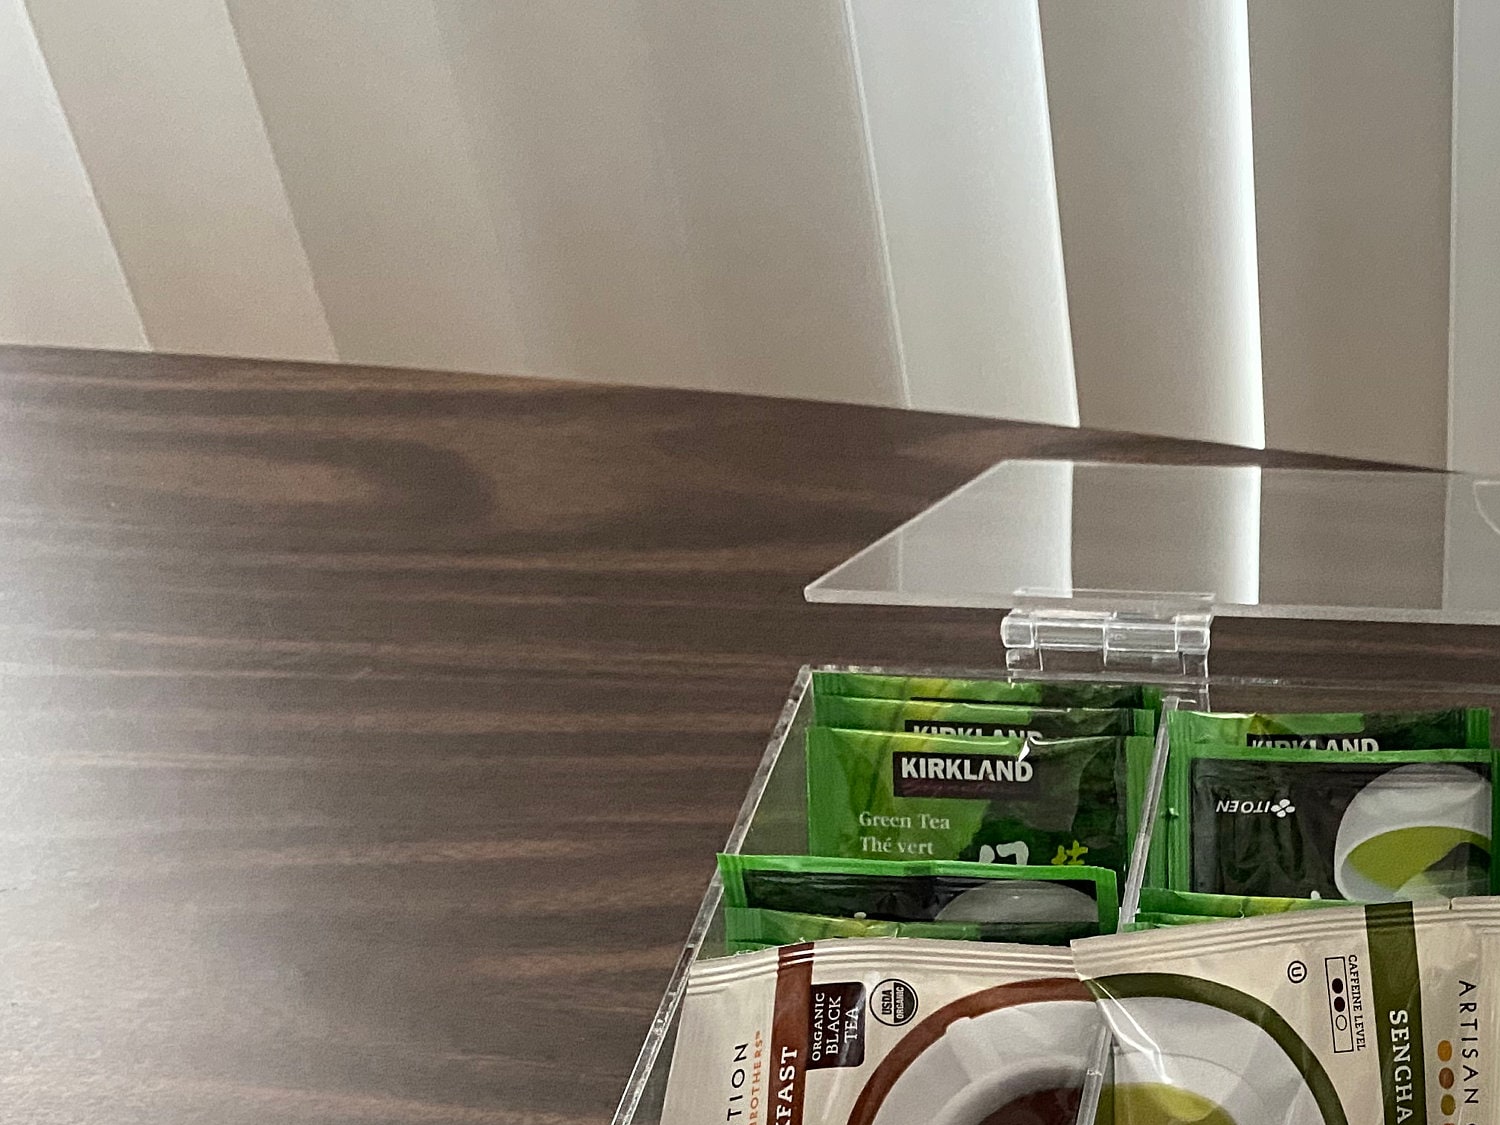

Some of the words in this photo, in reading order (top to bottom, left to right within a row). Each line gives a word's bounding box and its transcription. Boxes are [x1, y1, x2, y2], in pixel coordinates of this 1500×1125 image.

[902, 757, 1034, 782] KIRKLAND
[859, 811, 911, 829] Green
[918, 814, 950, 830] Tea
[859, 837, 892, 853] Thé
[897, 840, 934, 855] vert
[1349, 955, 1363, 1012] CAFFEINE
[882, 989, 892, 1015] USDA
[896, 986, 905, 1019] ORGANIC
[812, 992, 825, 1061] ORGANIC
[825, 996, 841, 1054] BLACK
[844, 1006, 859, 1043] TEA
[1354, 1015, 1366, 1051] LEVEL
[1459, 980, 1479, 1103] ARTISAN
[1389, 1010, 1414, 1124] SENCHA
